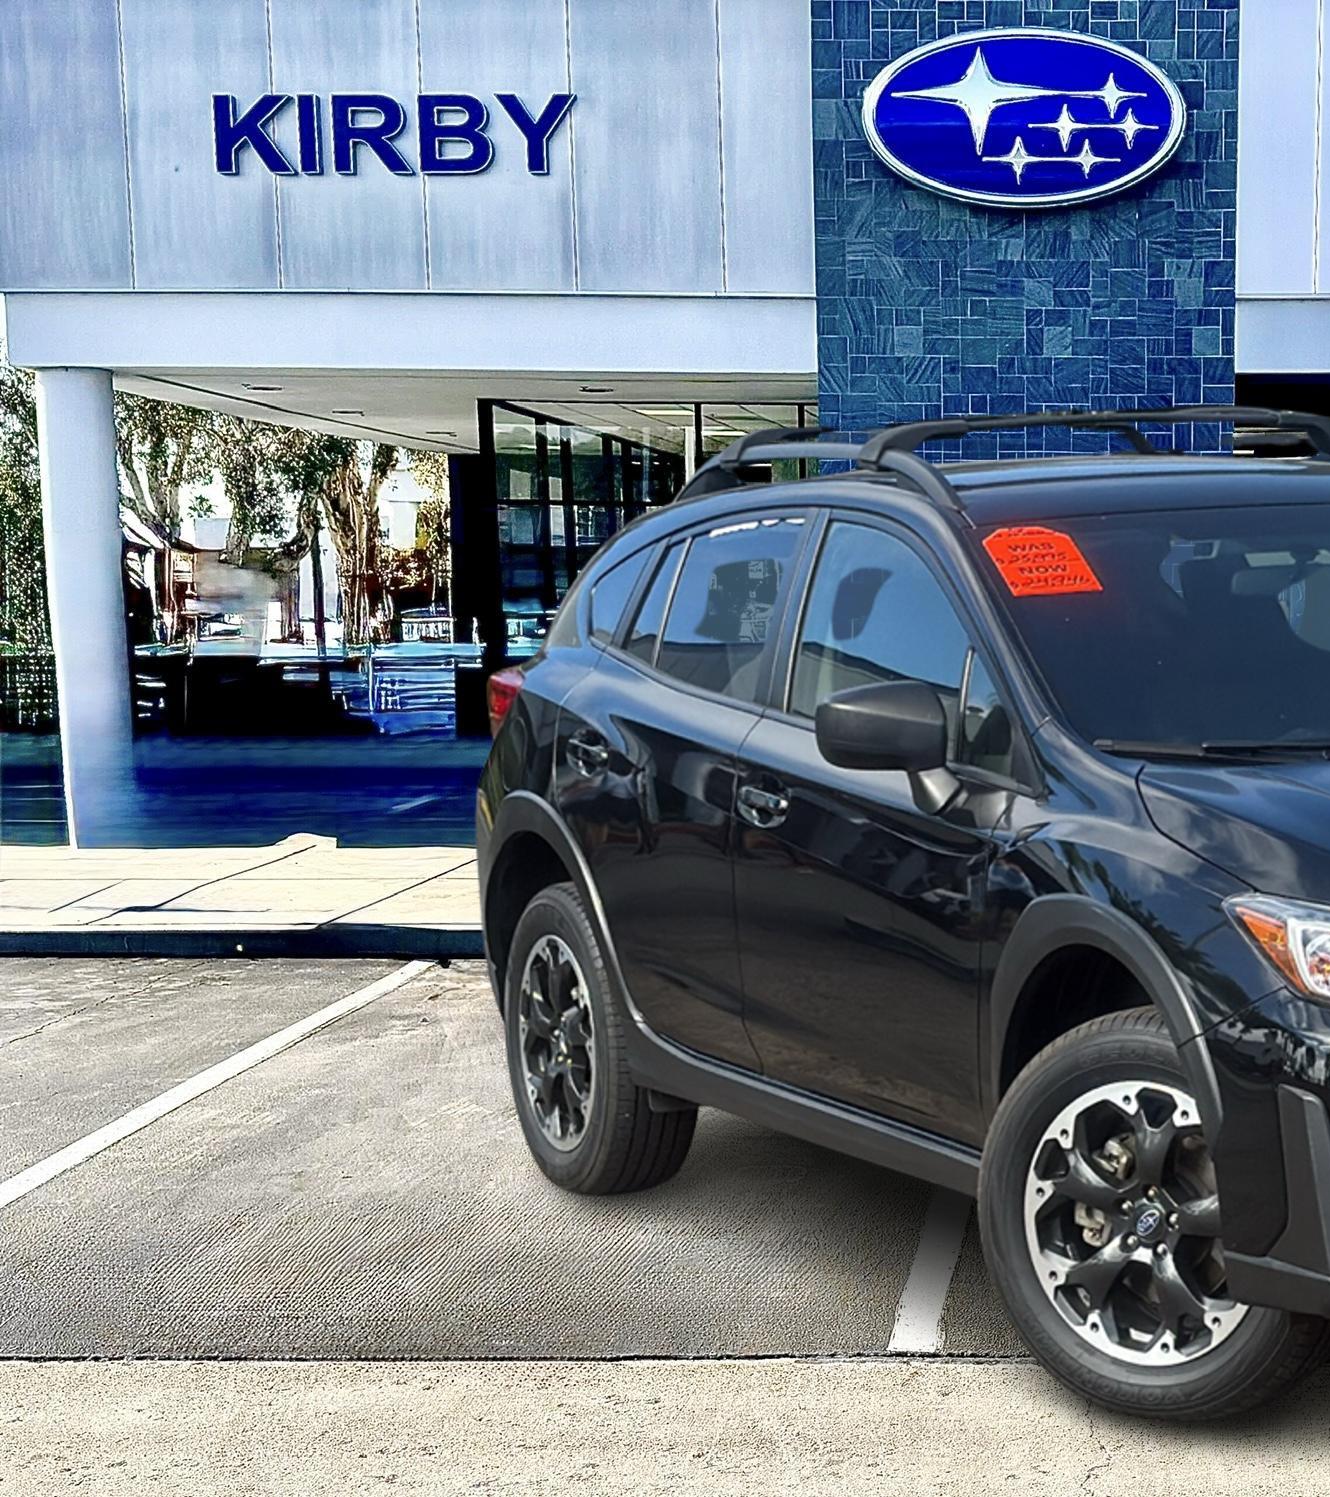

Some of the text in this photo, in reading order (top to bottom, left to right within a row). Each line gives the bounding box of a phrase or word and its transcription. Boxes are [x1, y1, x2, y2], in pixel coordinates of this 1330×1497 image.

[211, 92, 577, 176] KIRBY
[1007, 542, 1054, 553] WAS
[1018, 564, 1068, 575] NOW
